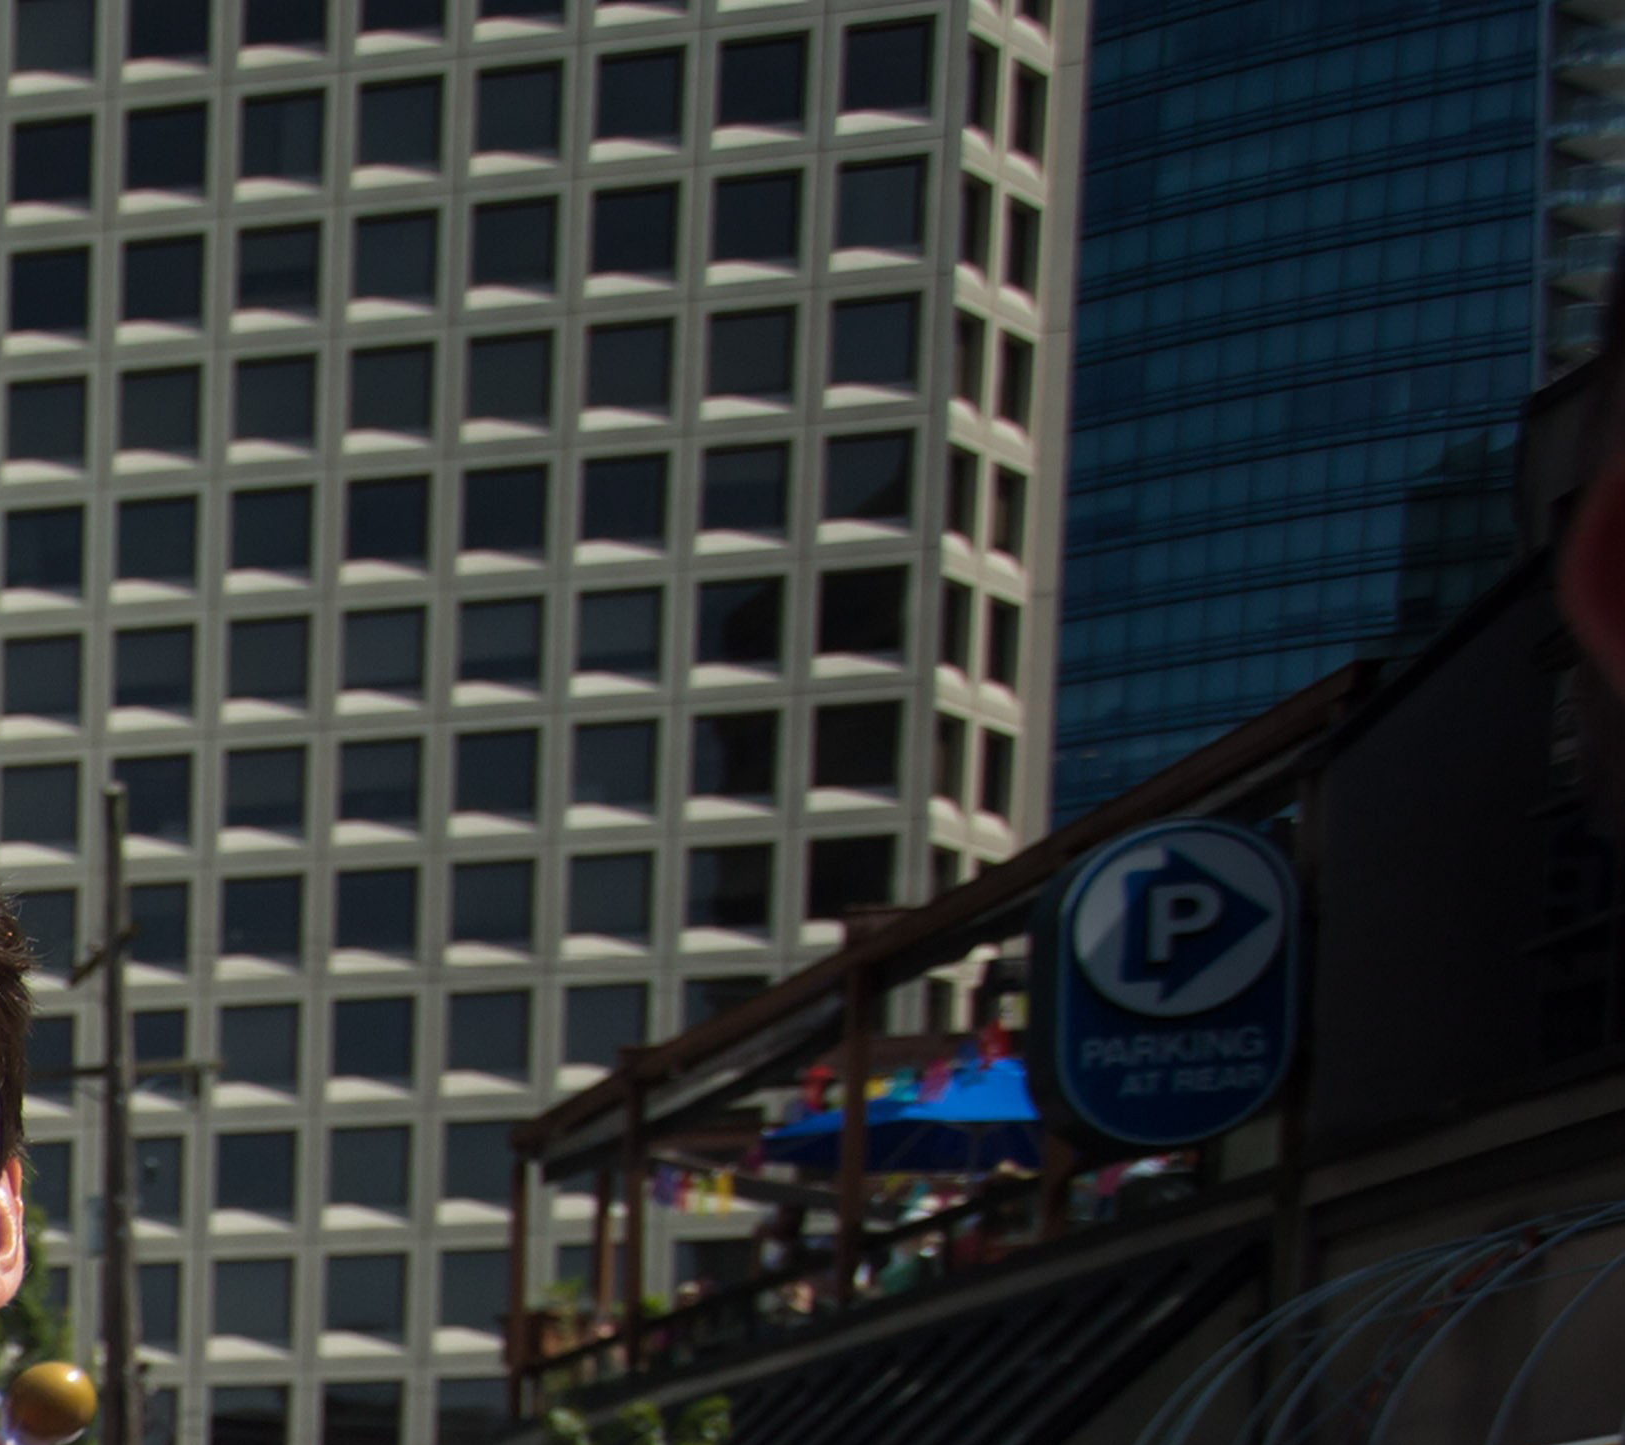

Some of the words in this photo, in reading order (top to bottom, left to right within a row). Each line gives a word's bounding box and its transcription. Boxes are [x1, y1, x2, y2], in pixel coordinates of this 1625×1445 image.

[1148, 883, 1223, 963] P
[1078, 1023, 1269, 1071] PARKING
[1117, 1069, 1165, 1098] AT
[1172, 1062, 1267, 1095] REAR
